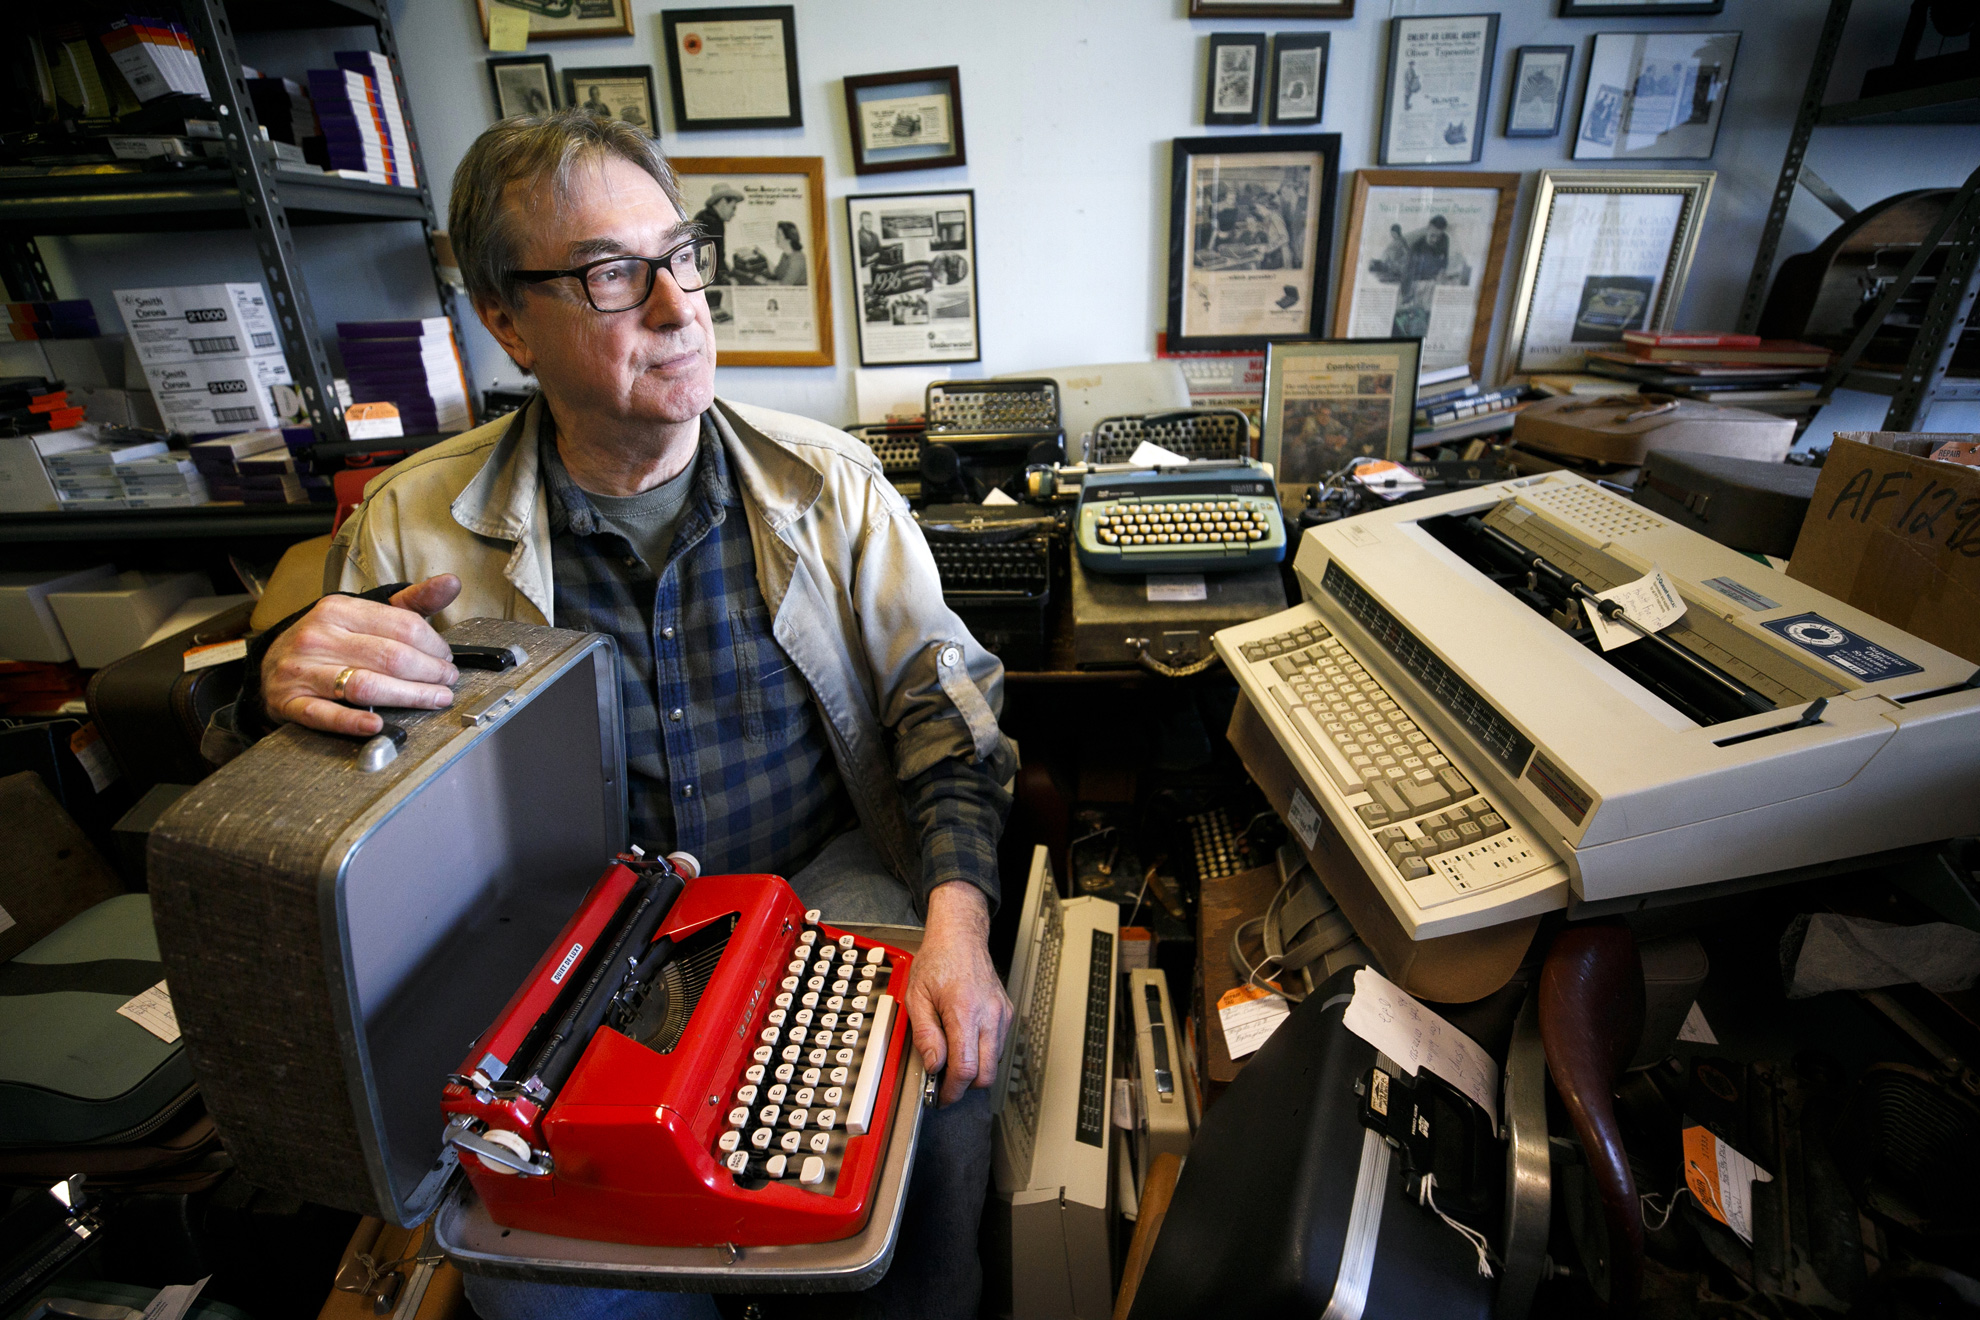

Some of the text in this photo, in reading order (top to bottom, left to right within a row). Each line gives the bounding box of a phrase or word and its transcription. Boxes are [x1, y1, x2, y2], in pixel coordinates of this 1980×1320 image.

[872, 271, 902, 292] 1936
[135, 295, 164, 307] Smith
[135, 308, 167, 319] Corona
[187, 310, 227, 321] 21000
[161, 368, 188, 378] Smith
[161, 380, 191, 390] Corona
[208, 380, 247, 393] 21000
[1938, 449, 1961, 458] REPAIR
[1406, 465, 1440, 477] OYAL
[1850, 649, 1890, 669] Systems
[1863, 650, 1893, 665] Office
[1864, 645, 1907, 667] Superior
[554, 945, 581, 981] QUIET DE LUXE
[736, 979, 767, 1040] ROYAL
